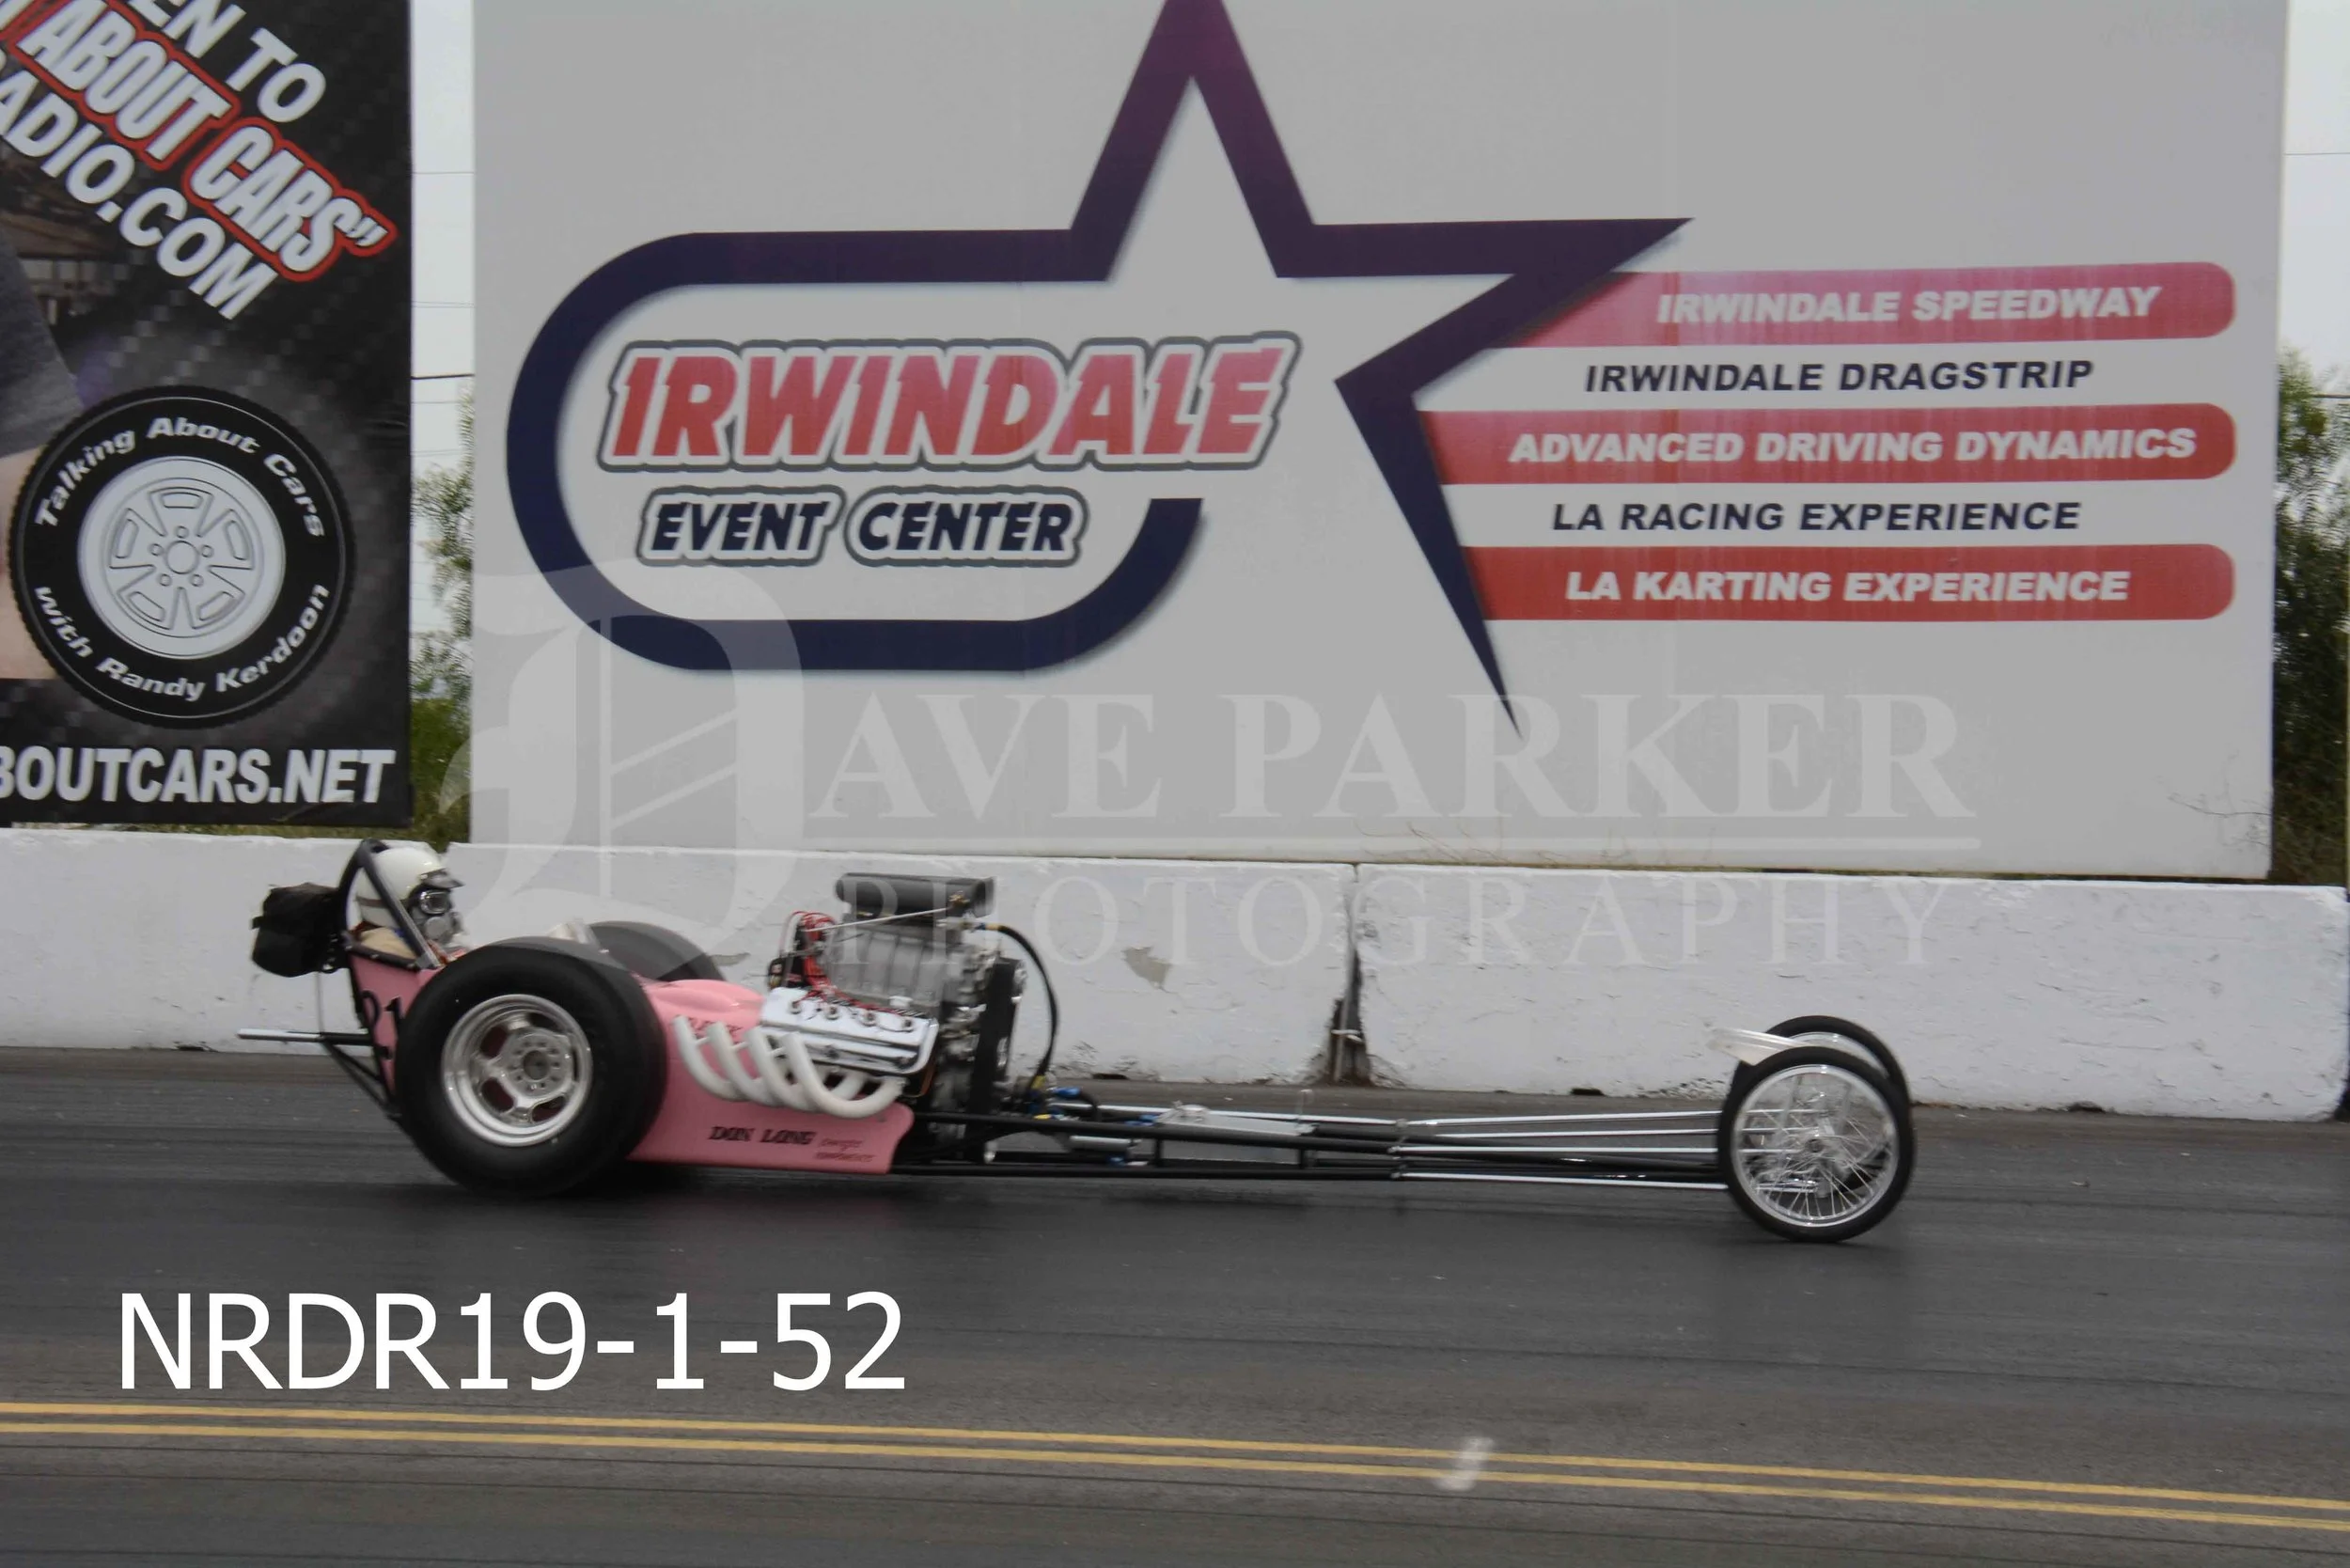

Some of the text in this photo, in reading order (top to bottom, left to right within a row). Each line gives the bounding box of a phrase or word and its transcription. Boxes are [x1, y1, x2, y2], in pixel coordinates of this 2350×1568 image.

[16, 0, 233, 161] ABOUT
[226, 27, 326, 122] TO
[0, 47, 279, 321] ADIO.COM
[1657, 286, 2162, 323] IRWINDALE SPEEDWAY
[607, 342, 1290, 461] IRWINDALE
[1585, 359, 2094, 393] IRWINDALE DRAGSTRIP
[1508, 427, 2199, 463] ADVANCED DRIVING DYNAMICS
[35, 416, 326, 539] Talking About Cars
[650, 499, 1074, 553] EVENT CENTER
[1552, 501, 2082, 531] LA RACING EXPERIENCE
[1565, 570, 2132, 602] LA KARTING EXPERIENCE
[35, 584, 330, 702] with Randy Kerdoon
[760, 1129, 818, 1146] LONG
